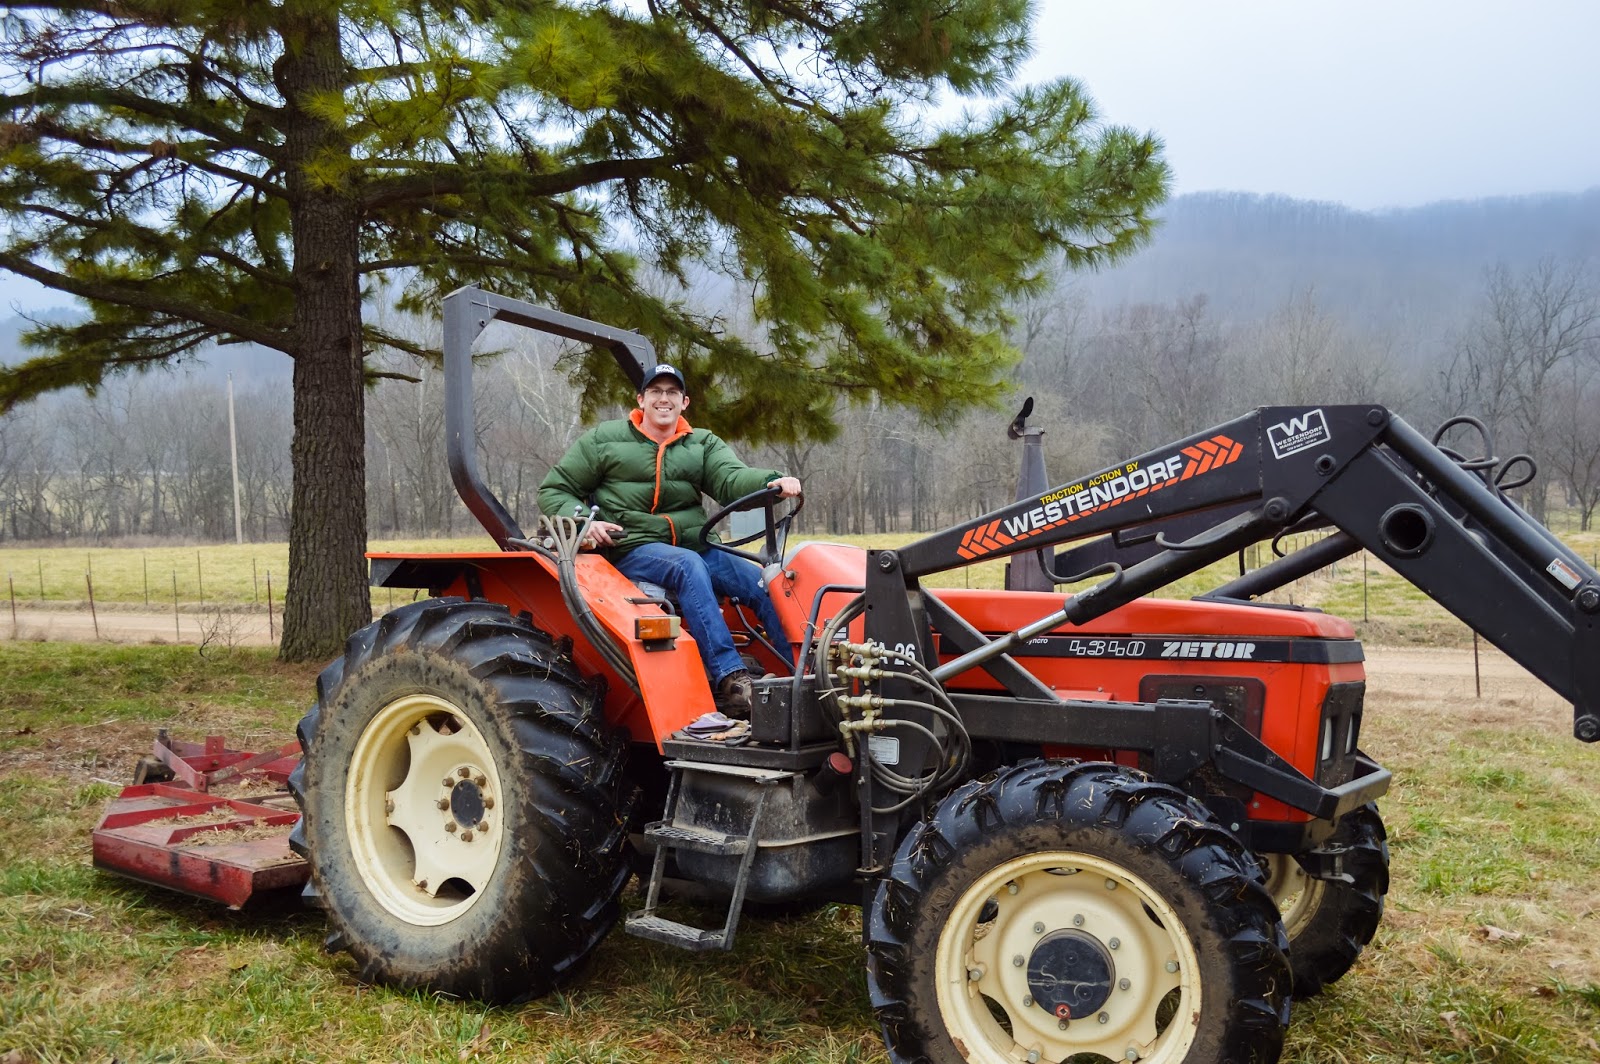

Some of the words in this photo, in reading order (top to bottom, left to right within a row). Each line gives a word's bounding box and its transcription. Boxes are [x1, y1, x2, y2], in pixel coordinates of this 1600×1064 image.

[1275, 425, 1323, 447] WESTENDORF
[1279, 431, 1323, 450] MANUFACTURING
[1040, 482, 1084, 505] TRACTION
[1088, 468, 1122, 488] ACTION
[1125, 461, 1139, 473] BY
[1003, 455, 1183, 537] WESTENDORF
[894, 643, 916, 667] 26
[1069, 640, 1146, 656] 4340
[1160, 641, 1256, 659] ZETOR
